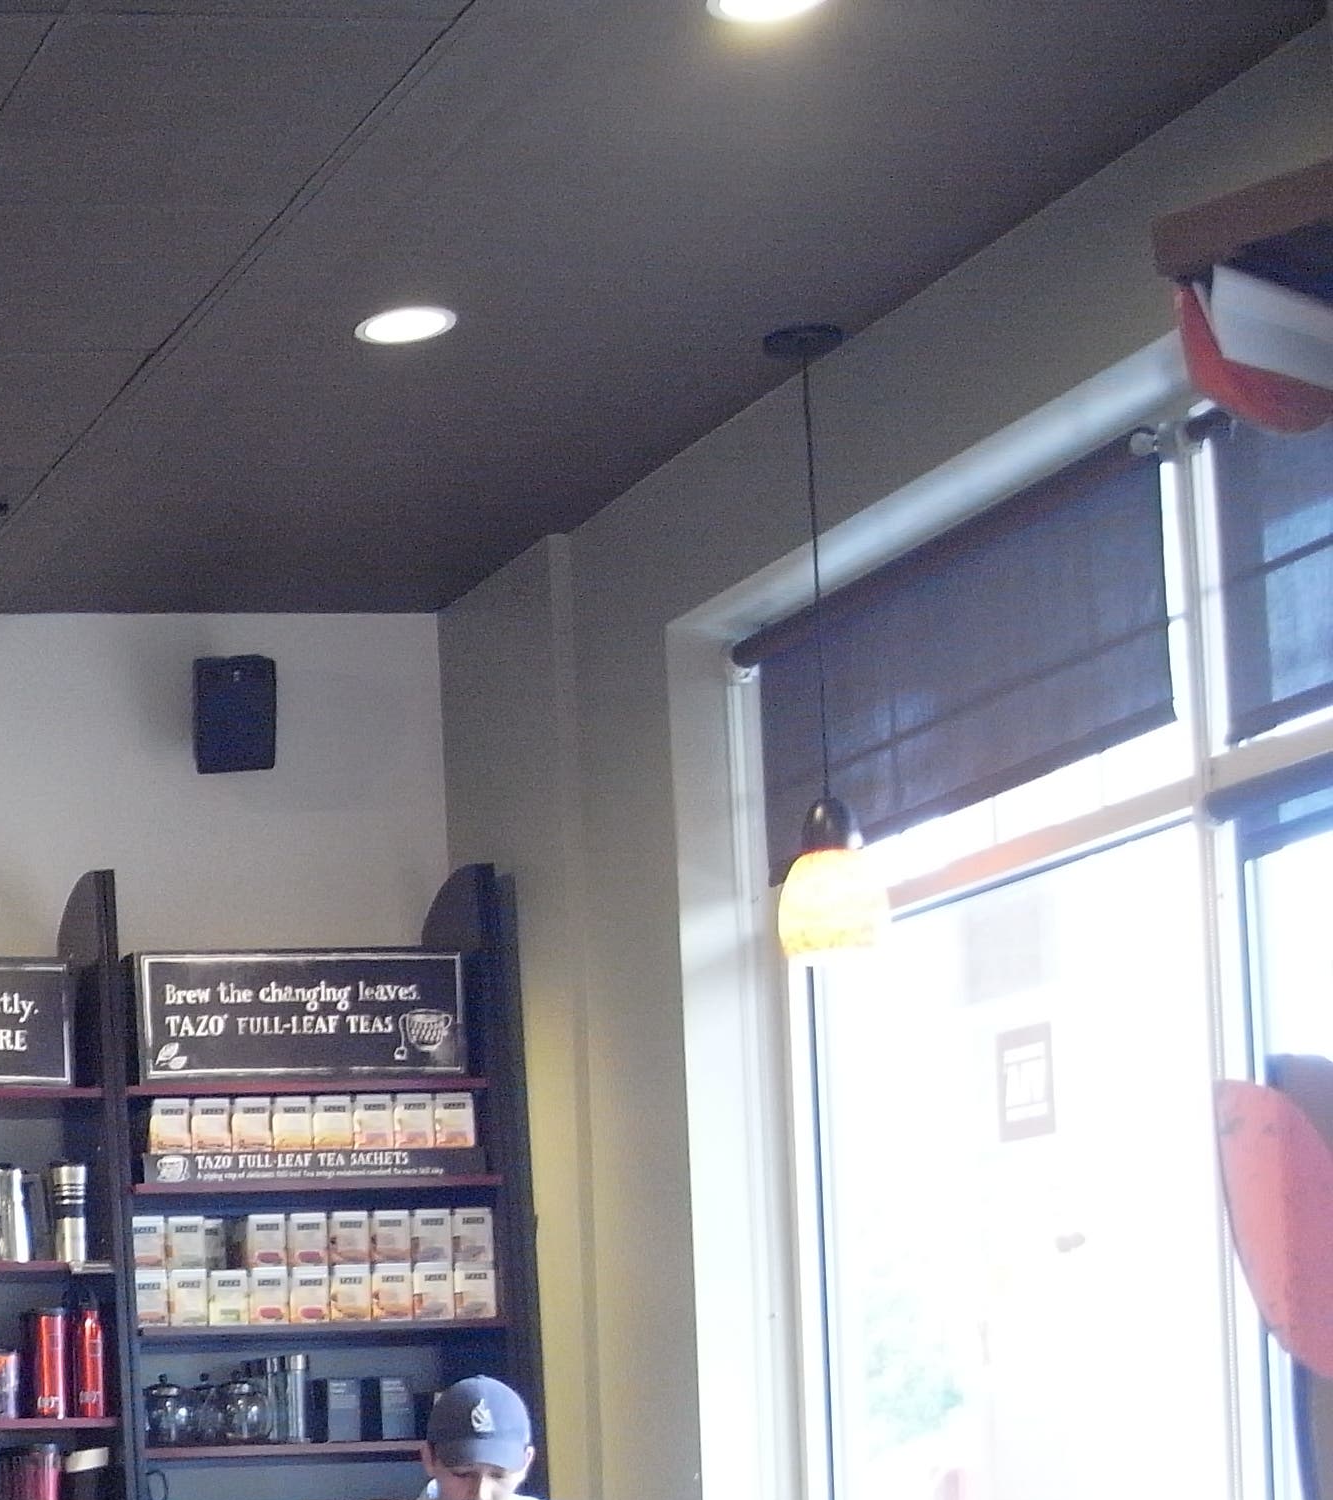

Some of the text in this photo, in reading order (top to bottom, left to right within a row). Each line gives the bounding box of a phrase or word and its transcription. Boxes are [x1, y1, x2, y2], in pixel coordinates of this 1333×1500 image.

[165, 983, 210, 1006] Brew
[217, 981, 252, 1004] the
[259, 980, 351, 1011] changing
[236, 1015, 339, 1035] FULL-LEAF
[346, 1014, 393, 1034] TEAS
[317, 1152, 345, 1167] TEA
[350, 1151, 410, 1165] SACHETS
